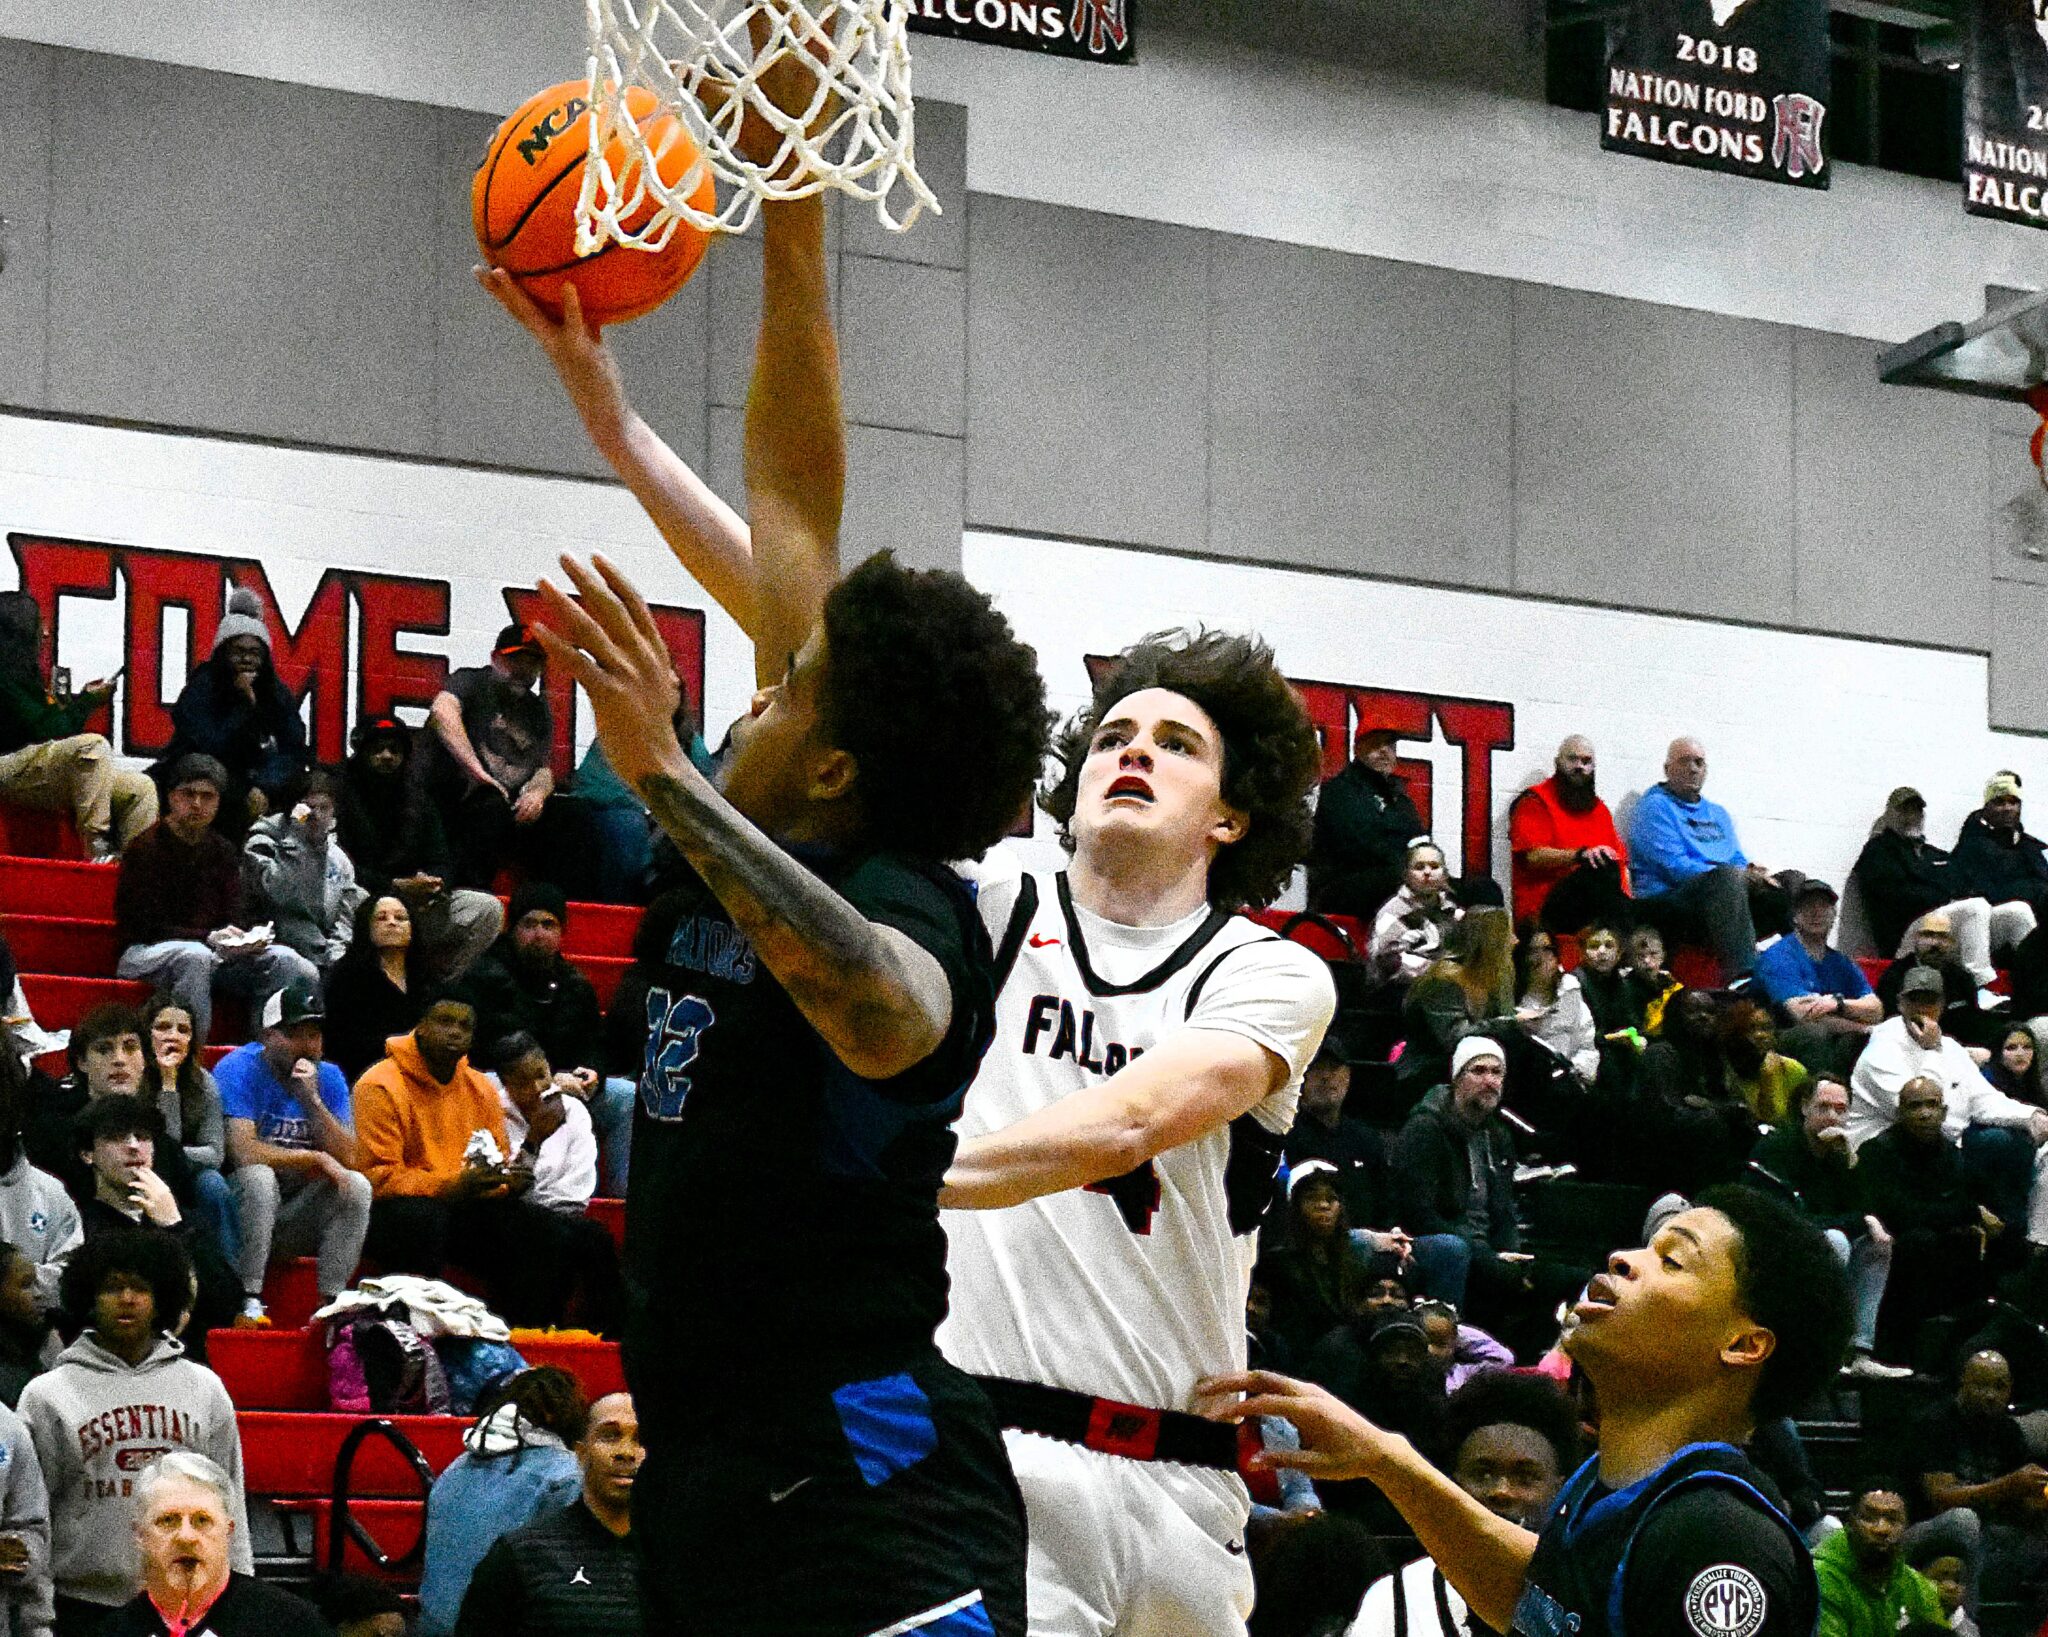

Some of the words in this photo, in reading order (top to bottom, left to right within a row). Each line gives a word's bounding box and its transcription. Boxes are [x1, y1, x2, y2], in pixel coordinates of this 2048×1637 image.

[907, 0, 1065, 38] LCONS
[1676, 32, 1758, 74] 2018
[1609, 66, 1700, 110] NATION
[1704, 86, 1768, 123] FORD
[1607, 107, 1764, 164] FALCONS
[2027, 105, 2048, 130] 2
[1967, 136, 2048, 180] NATION
[1691, 1569, 1728, 1604] PERSONALIZE
[1730, 1570, 1749, 1585] YOUR
